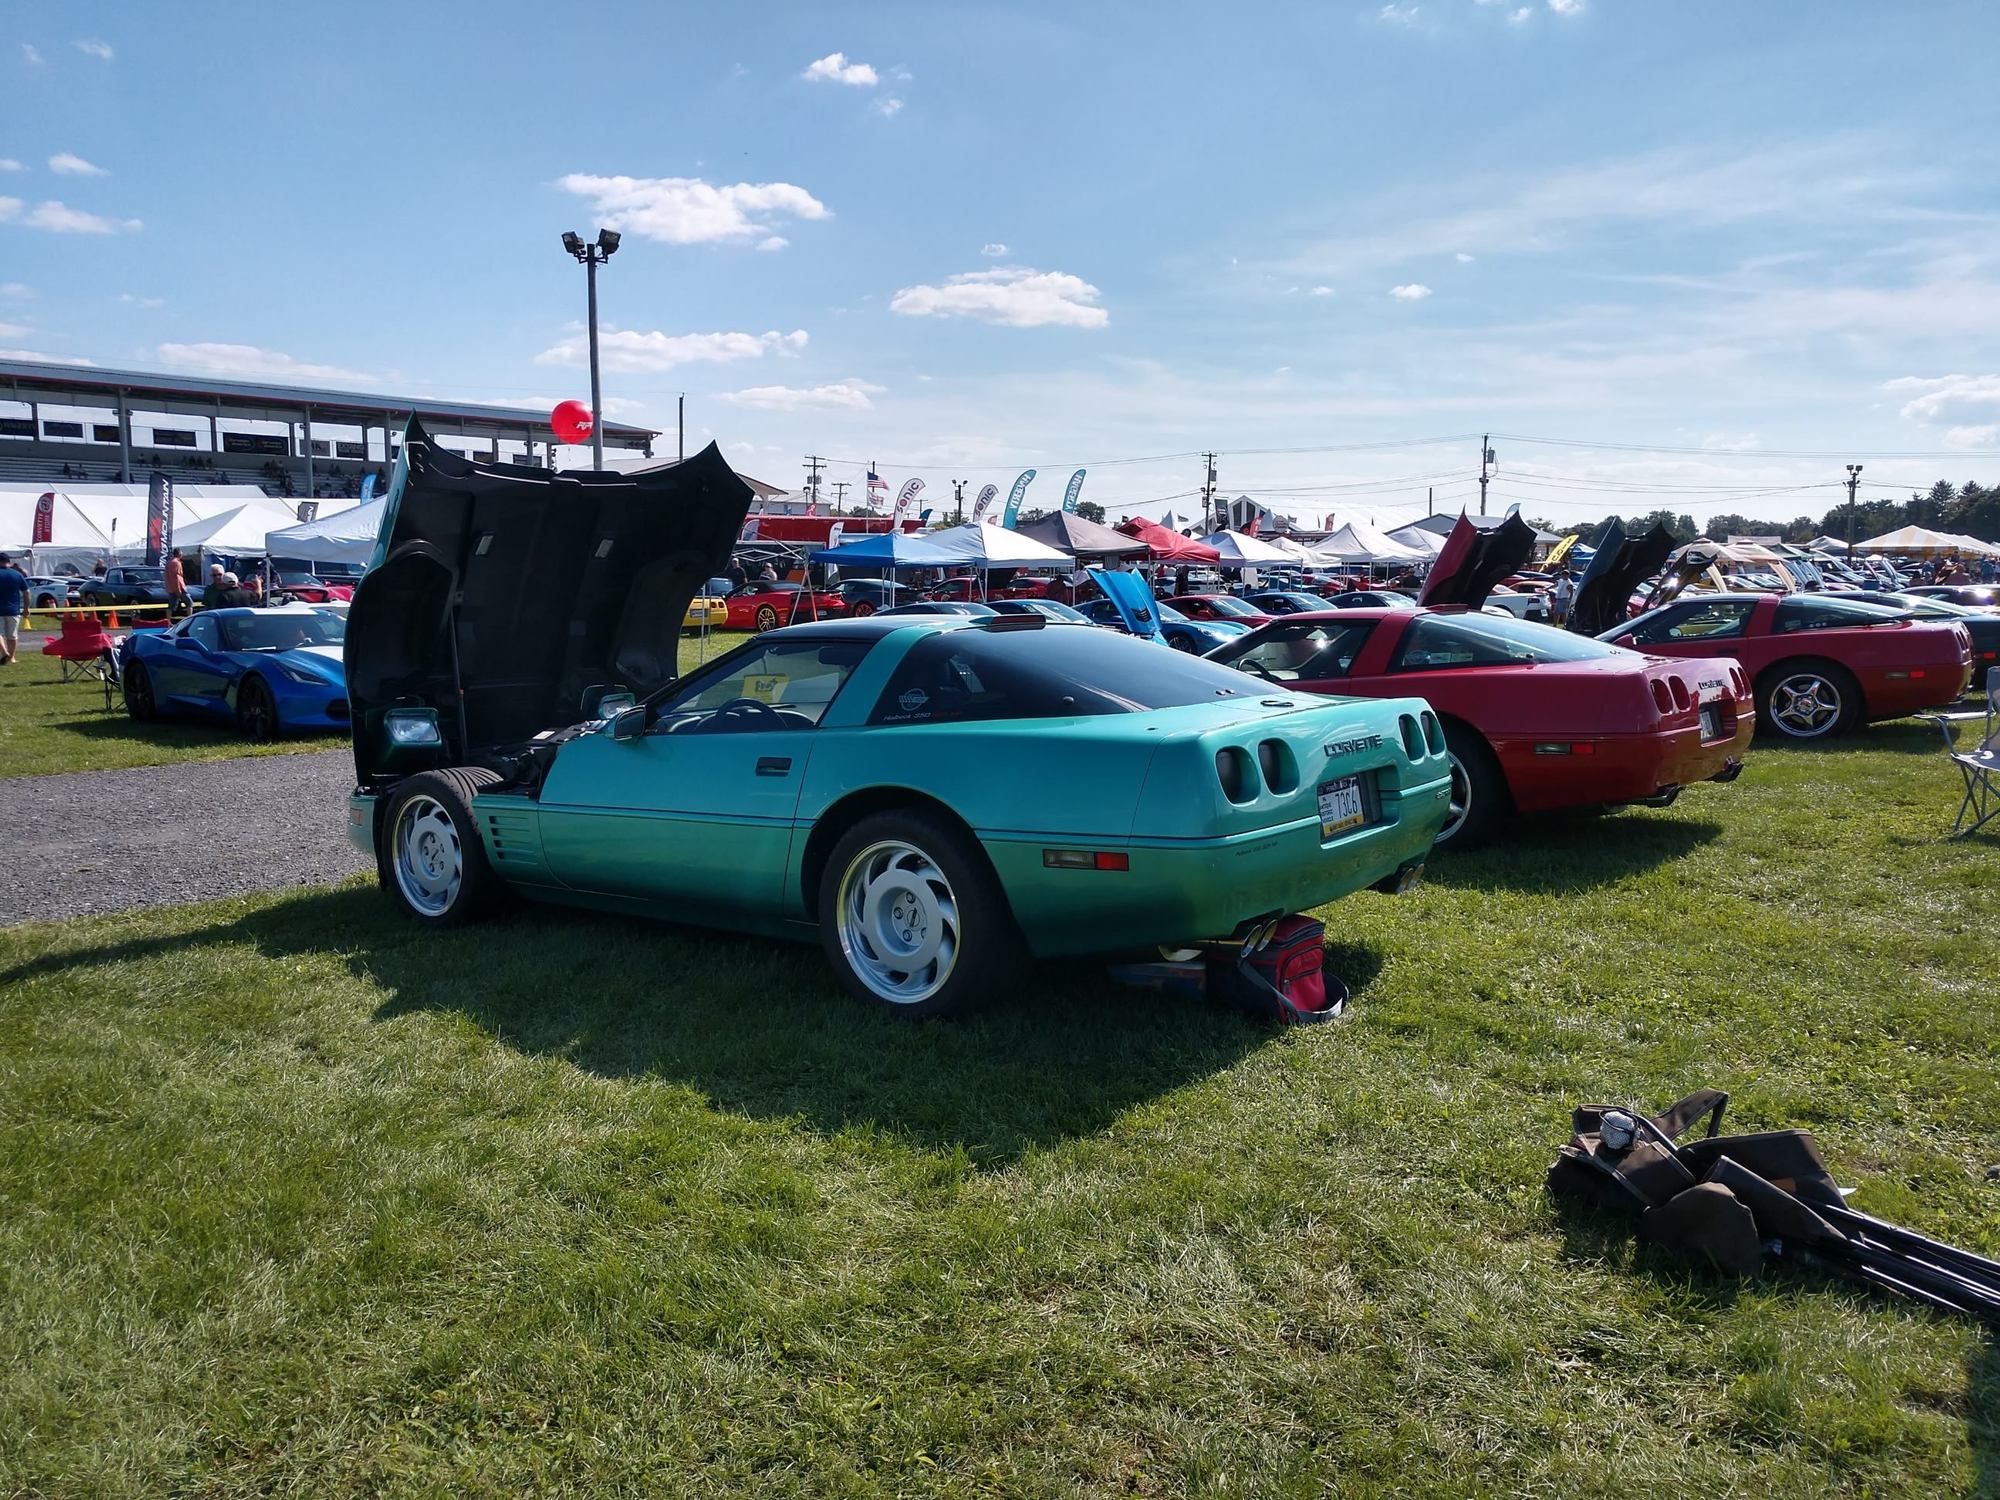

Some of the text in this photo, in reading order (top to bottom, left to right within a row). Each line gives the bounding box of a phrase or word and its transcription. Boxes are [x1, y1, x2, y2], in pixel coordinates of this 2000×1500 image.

[161, 479, 170, 544] MOUNTAIN
[896, 482, 919, 514] SONIC
[975, 487, 994, 516] SONIC
[1324, 734, 1383, 757] CORVETTE
[1335, 791, 1357, 818] 73C6
